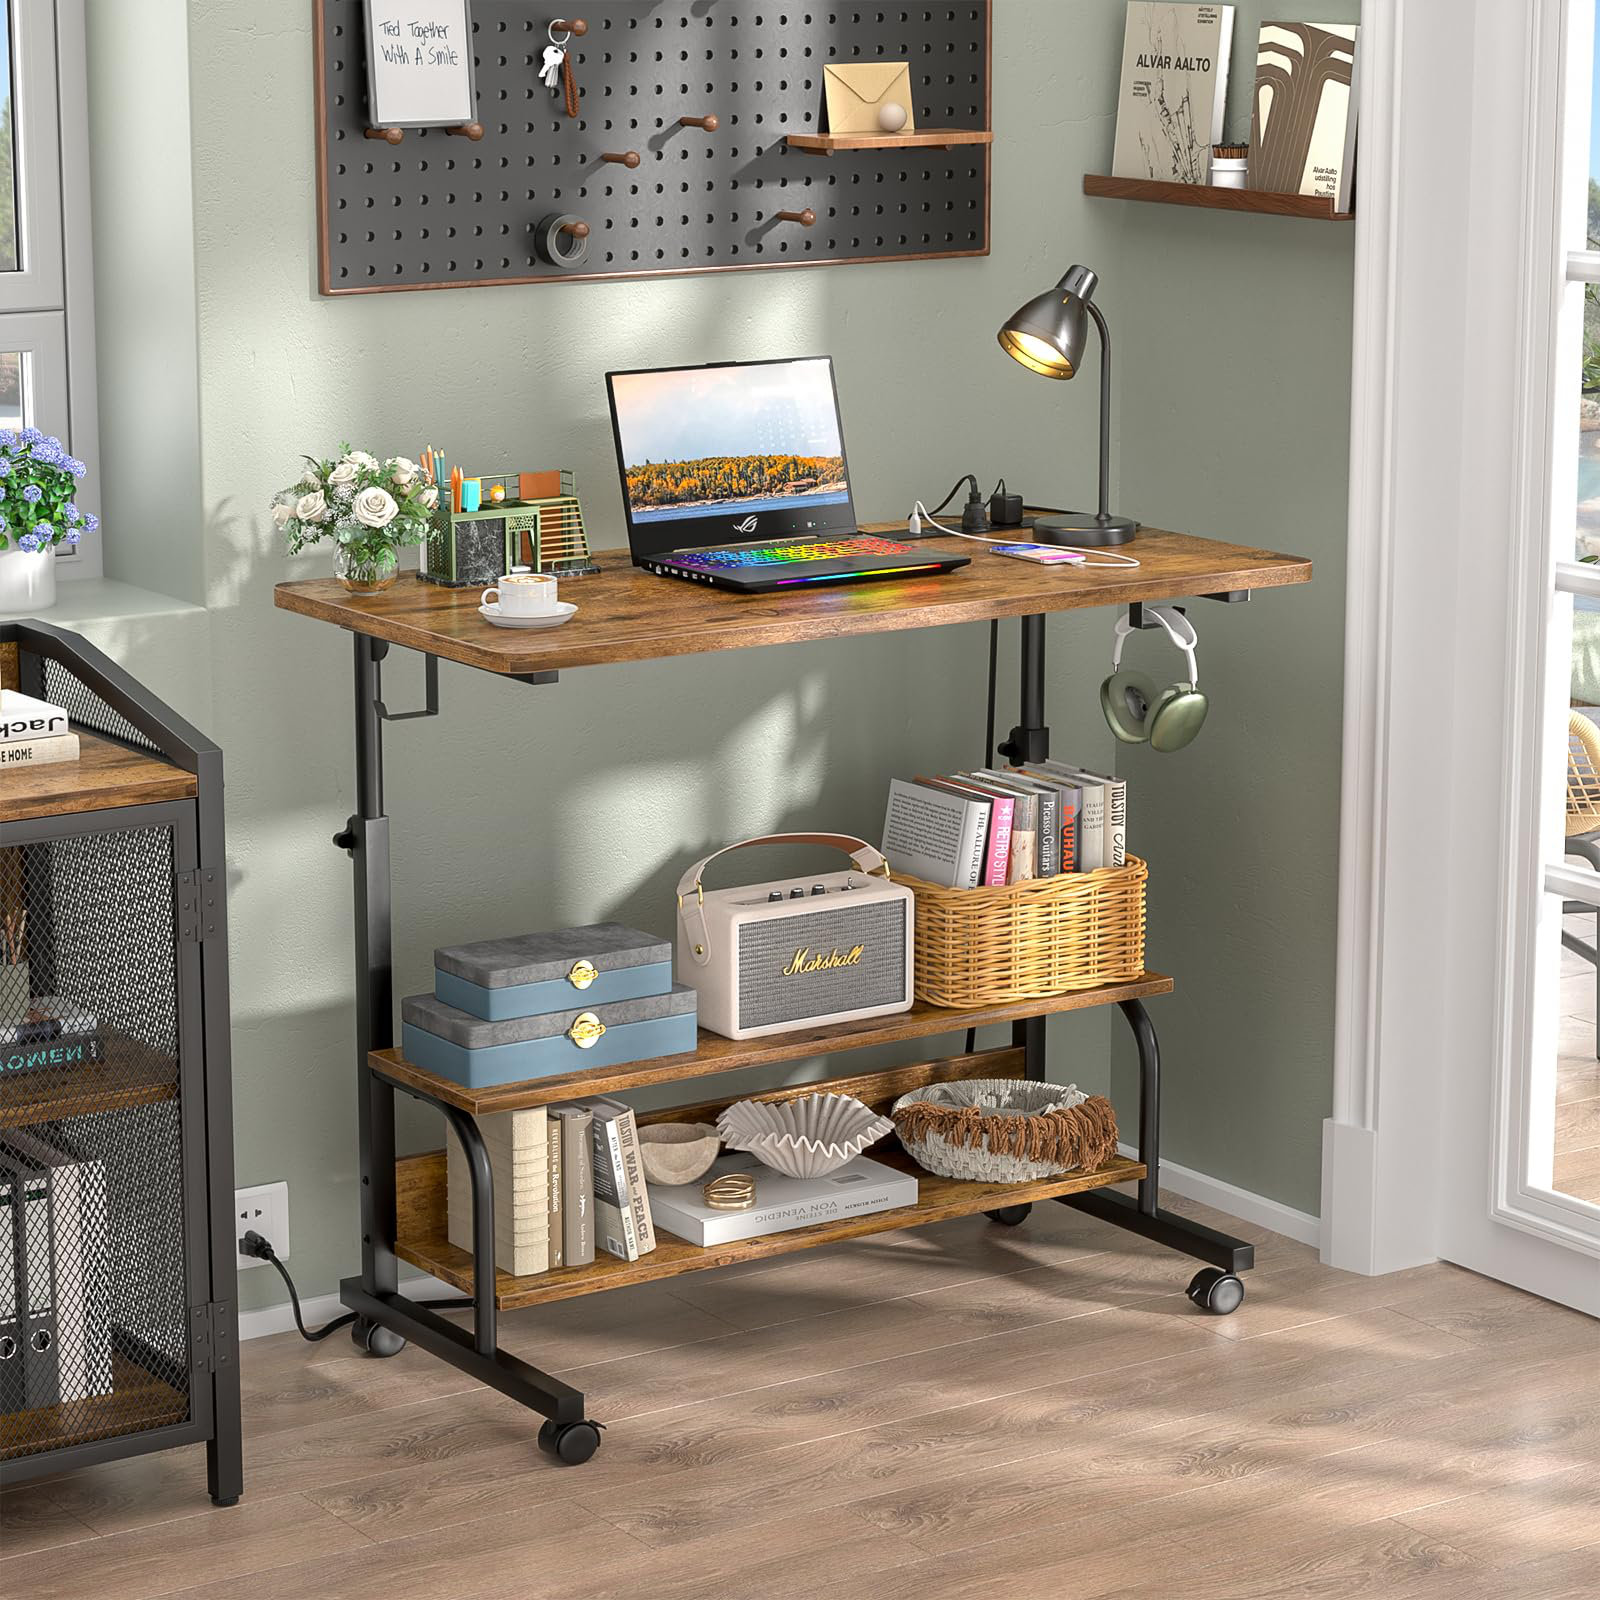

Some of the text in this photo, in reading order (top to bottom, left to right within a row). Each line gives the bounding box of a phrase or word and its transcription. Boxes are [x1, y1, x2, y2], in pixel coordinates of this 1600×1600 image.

[379, 20, 449, 46] Tied Together
[381, 44, 458, 66] With A Smile
[1136, 54, 1211, 72] ALVAR AALTO
[8, 748, 32, 762] HOME
[977, 811, 986, 830] THE
[1111, 785, 1124, 826] TOLSTOY
[971, 832, 983, 869] ALLURE
[994, 826, 1011, 858] RETRO
[1041, 801, 1055, 871] Picasso Guitars
[1063, 805, 1075, 874] BAUHAU
[969, 871, 977, 884] OF
[783, 944, 865, 976] Marshall
[619, 1115, 634, 1148] TOLSTOY
[625, 1150, 639, 1186] WAR
[633, 1196, 649, 1241] PEACE
[755, 1201, 838, 1223] VON VENEDIG
